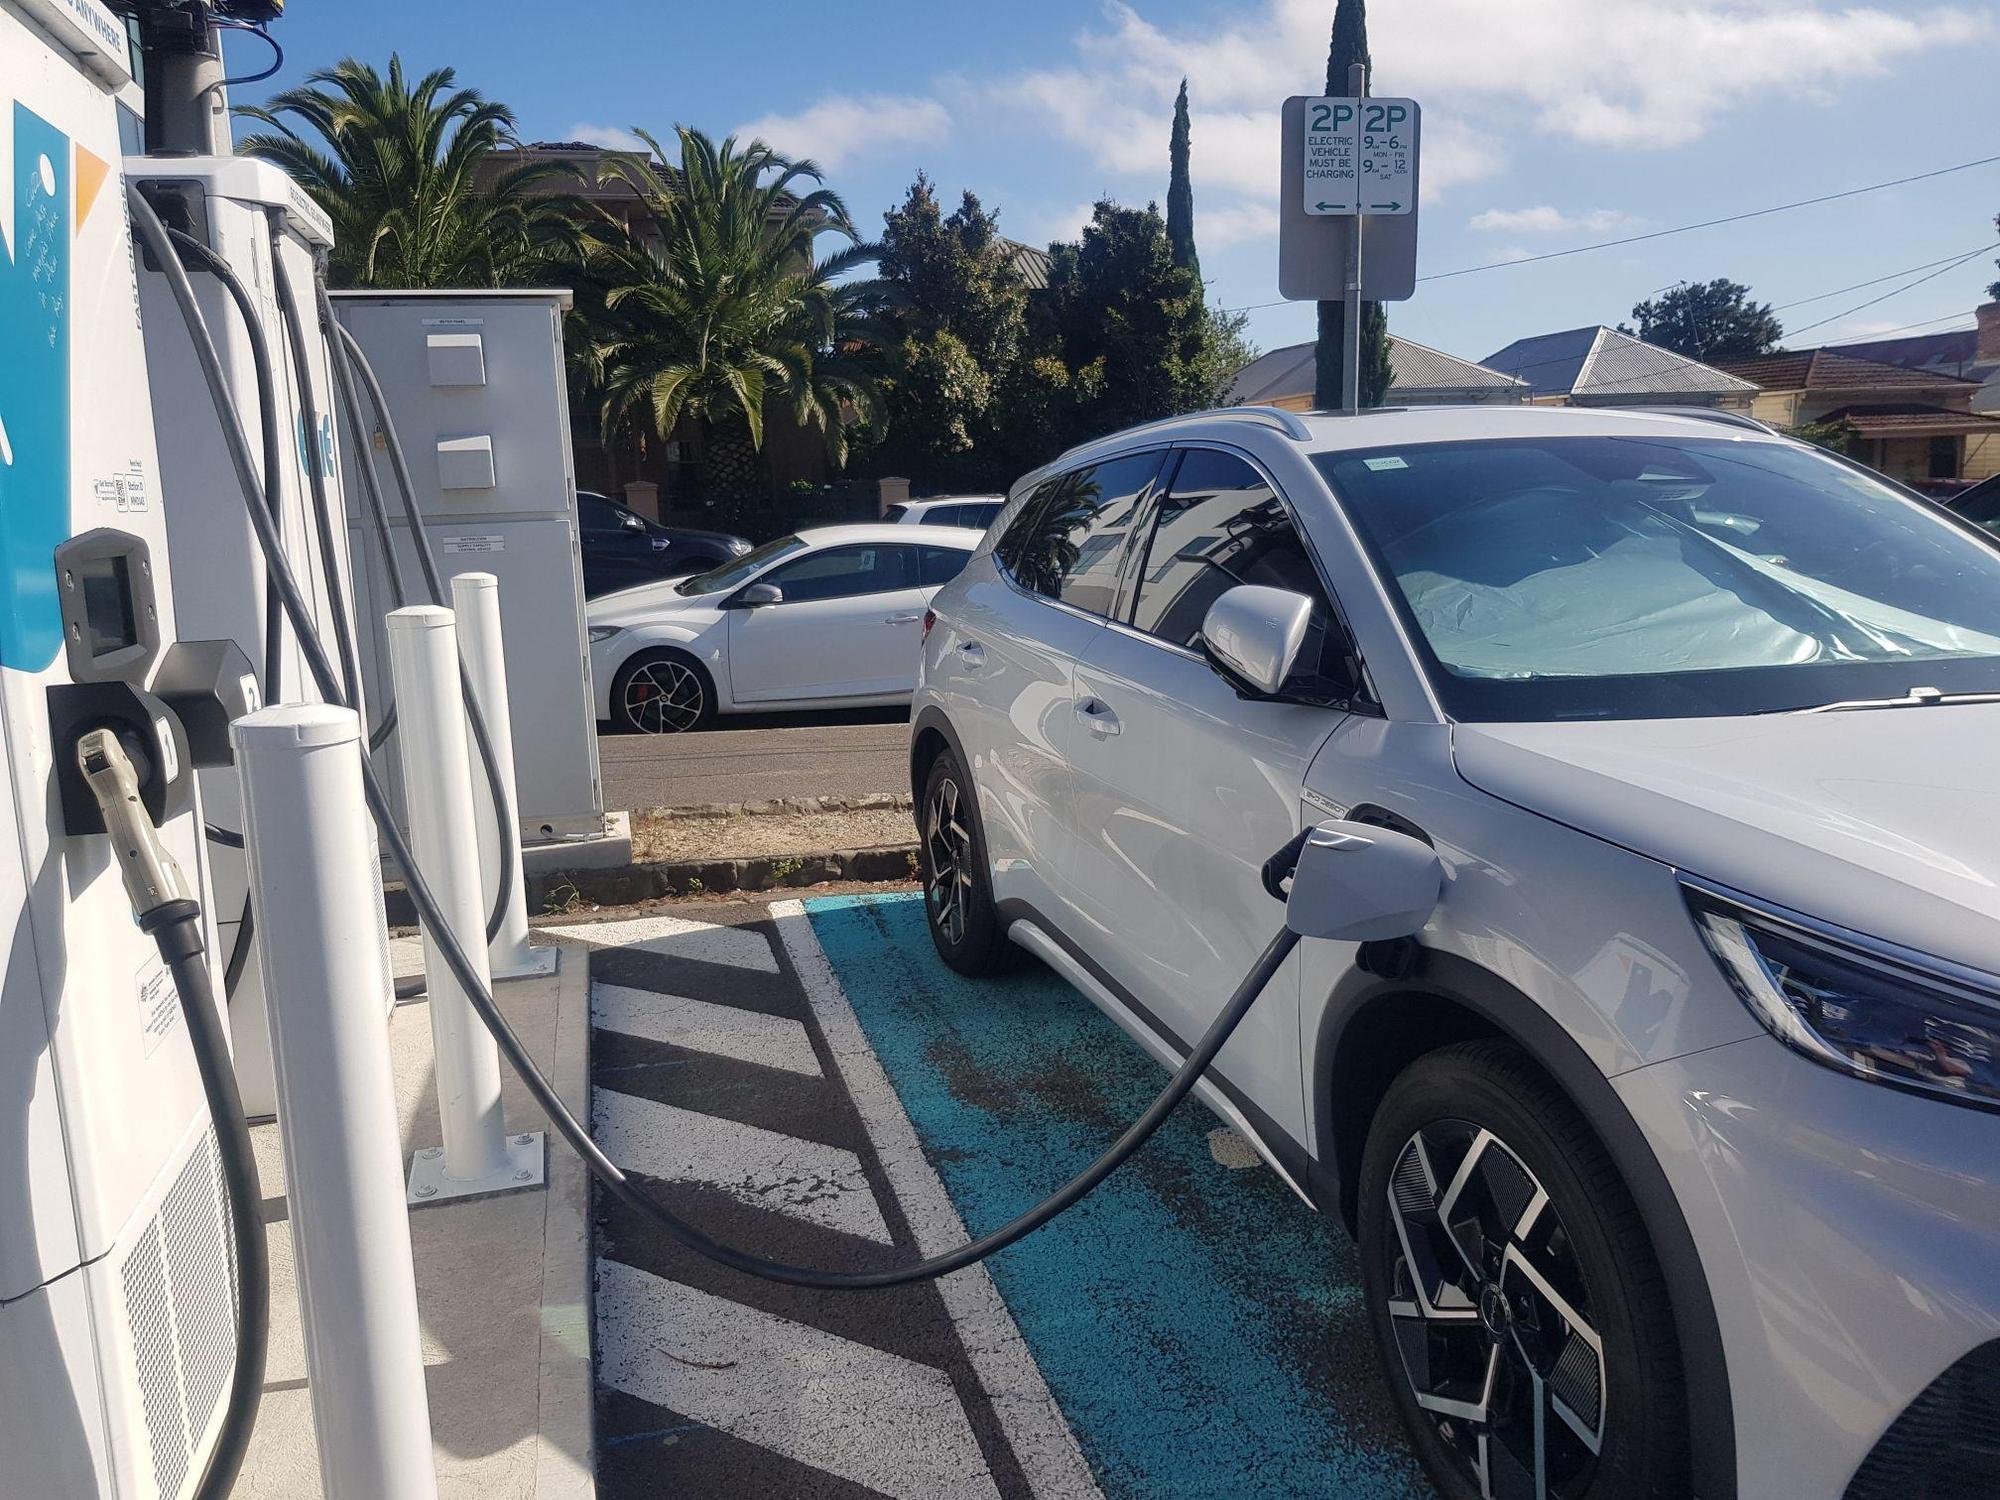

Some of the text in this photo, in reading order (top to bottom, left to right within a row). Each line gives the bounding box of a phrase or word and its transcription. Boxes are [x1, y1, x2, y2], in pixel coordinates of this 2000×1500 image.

[1311, 104, 1354, 132] 2P
[1365, 105, 1407, 132] 2P
[1308, 136, 1353, 146] ELECTRIC
[1311, 147, 1351, 157] VEHICLE
[1309, 158, 1351, 168] MUST BE
[1394, 159, 1406, 169] 12
[1306, 169, 1354, 179] CHARGING
[248, 687, 259, 714] 2
[164, 733, 173, 766] 1
